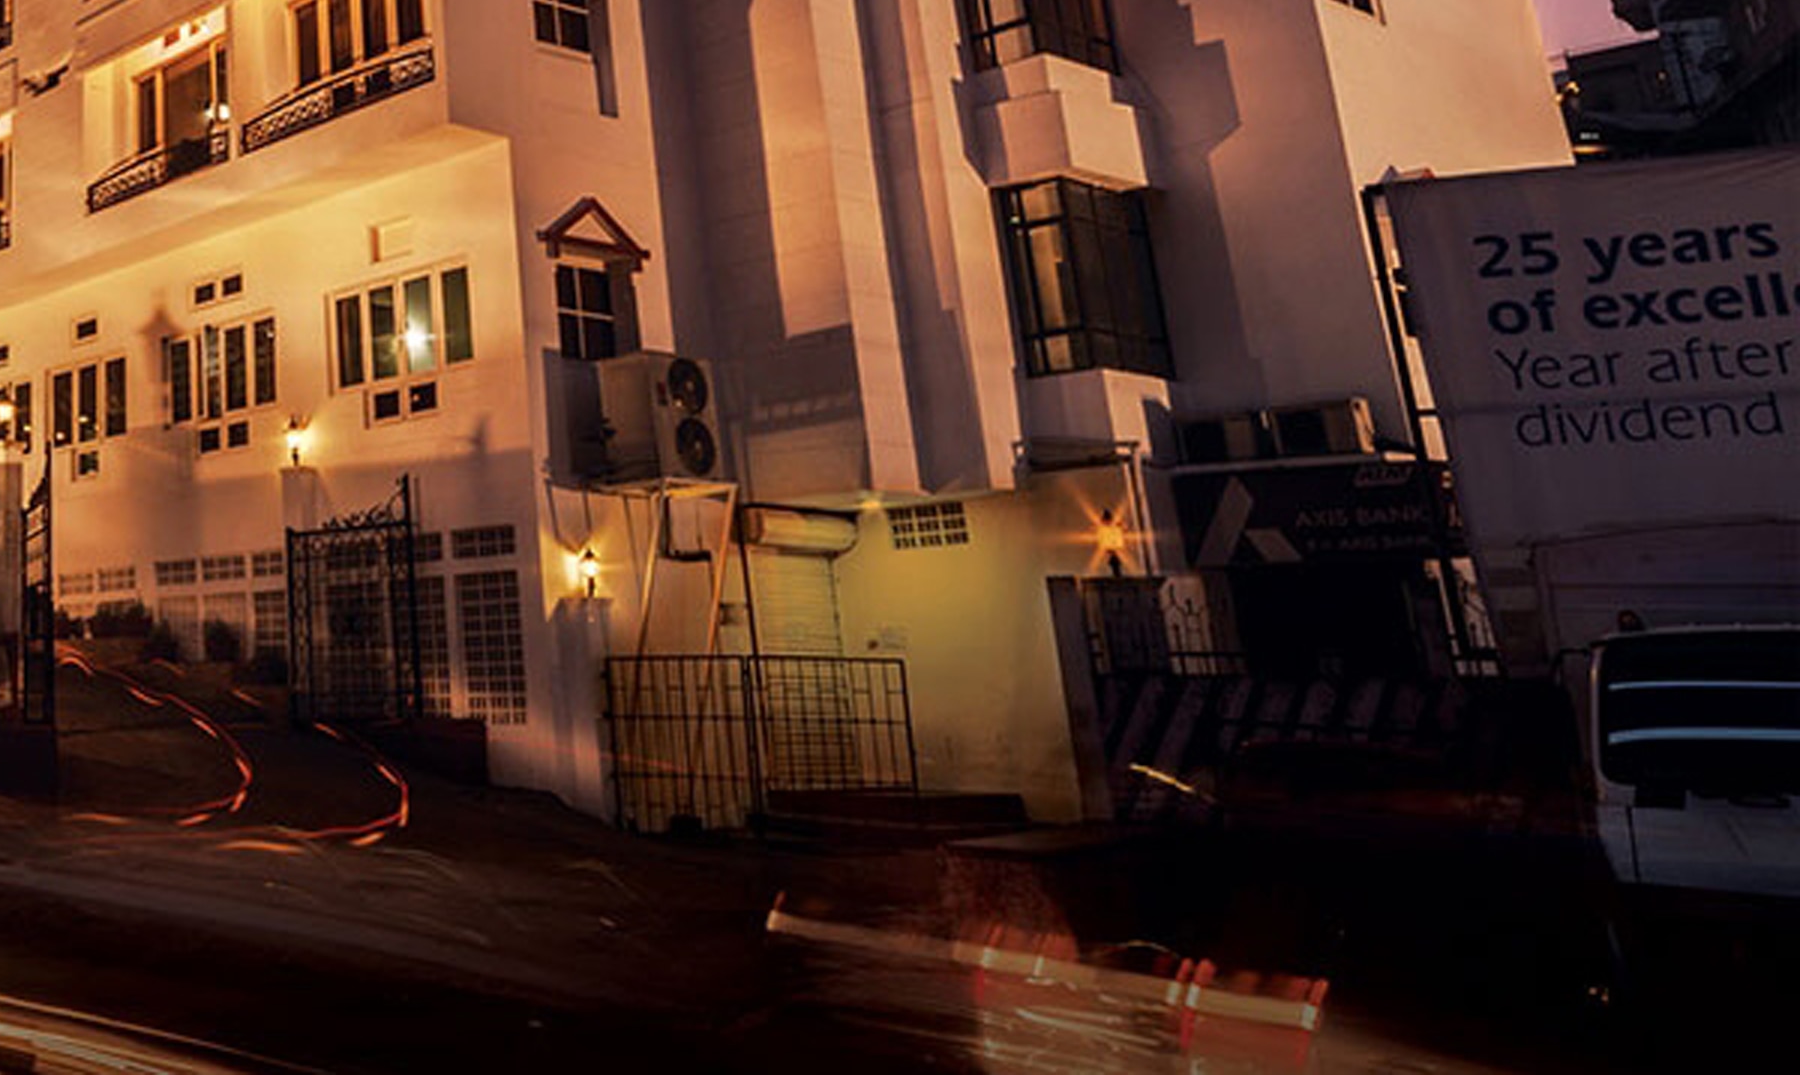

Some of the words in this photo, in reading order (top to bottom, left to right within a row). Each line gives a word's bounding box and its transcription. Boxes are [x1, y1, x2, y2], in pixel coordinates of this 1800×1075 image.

[1473, 231, 1559, 278] 25
[1583, 223, 1780, 284] years
[1488, 289, 1556, 335] of
[1583, 272, 1800, 329] excell
[1495, 348, 1623, 390] Year
[1648, 336, 1792, 384] after
[1516, 391, 1784, 447] dividend
[1295, 507, 1349, 527] AXIS
[1356, 504, 1429, 526] BANK
